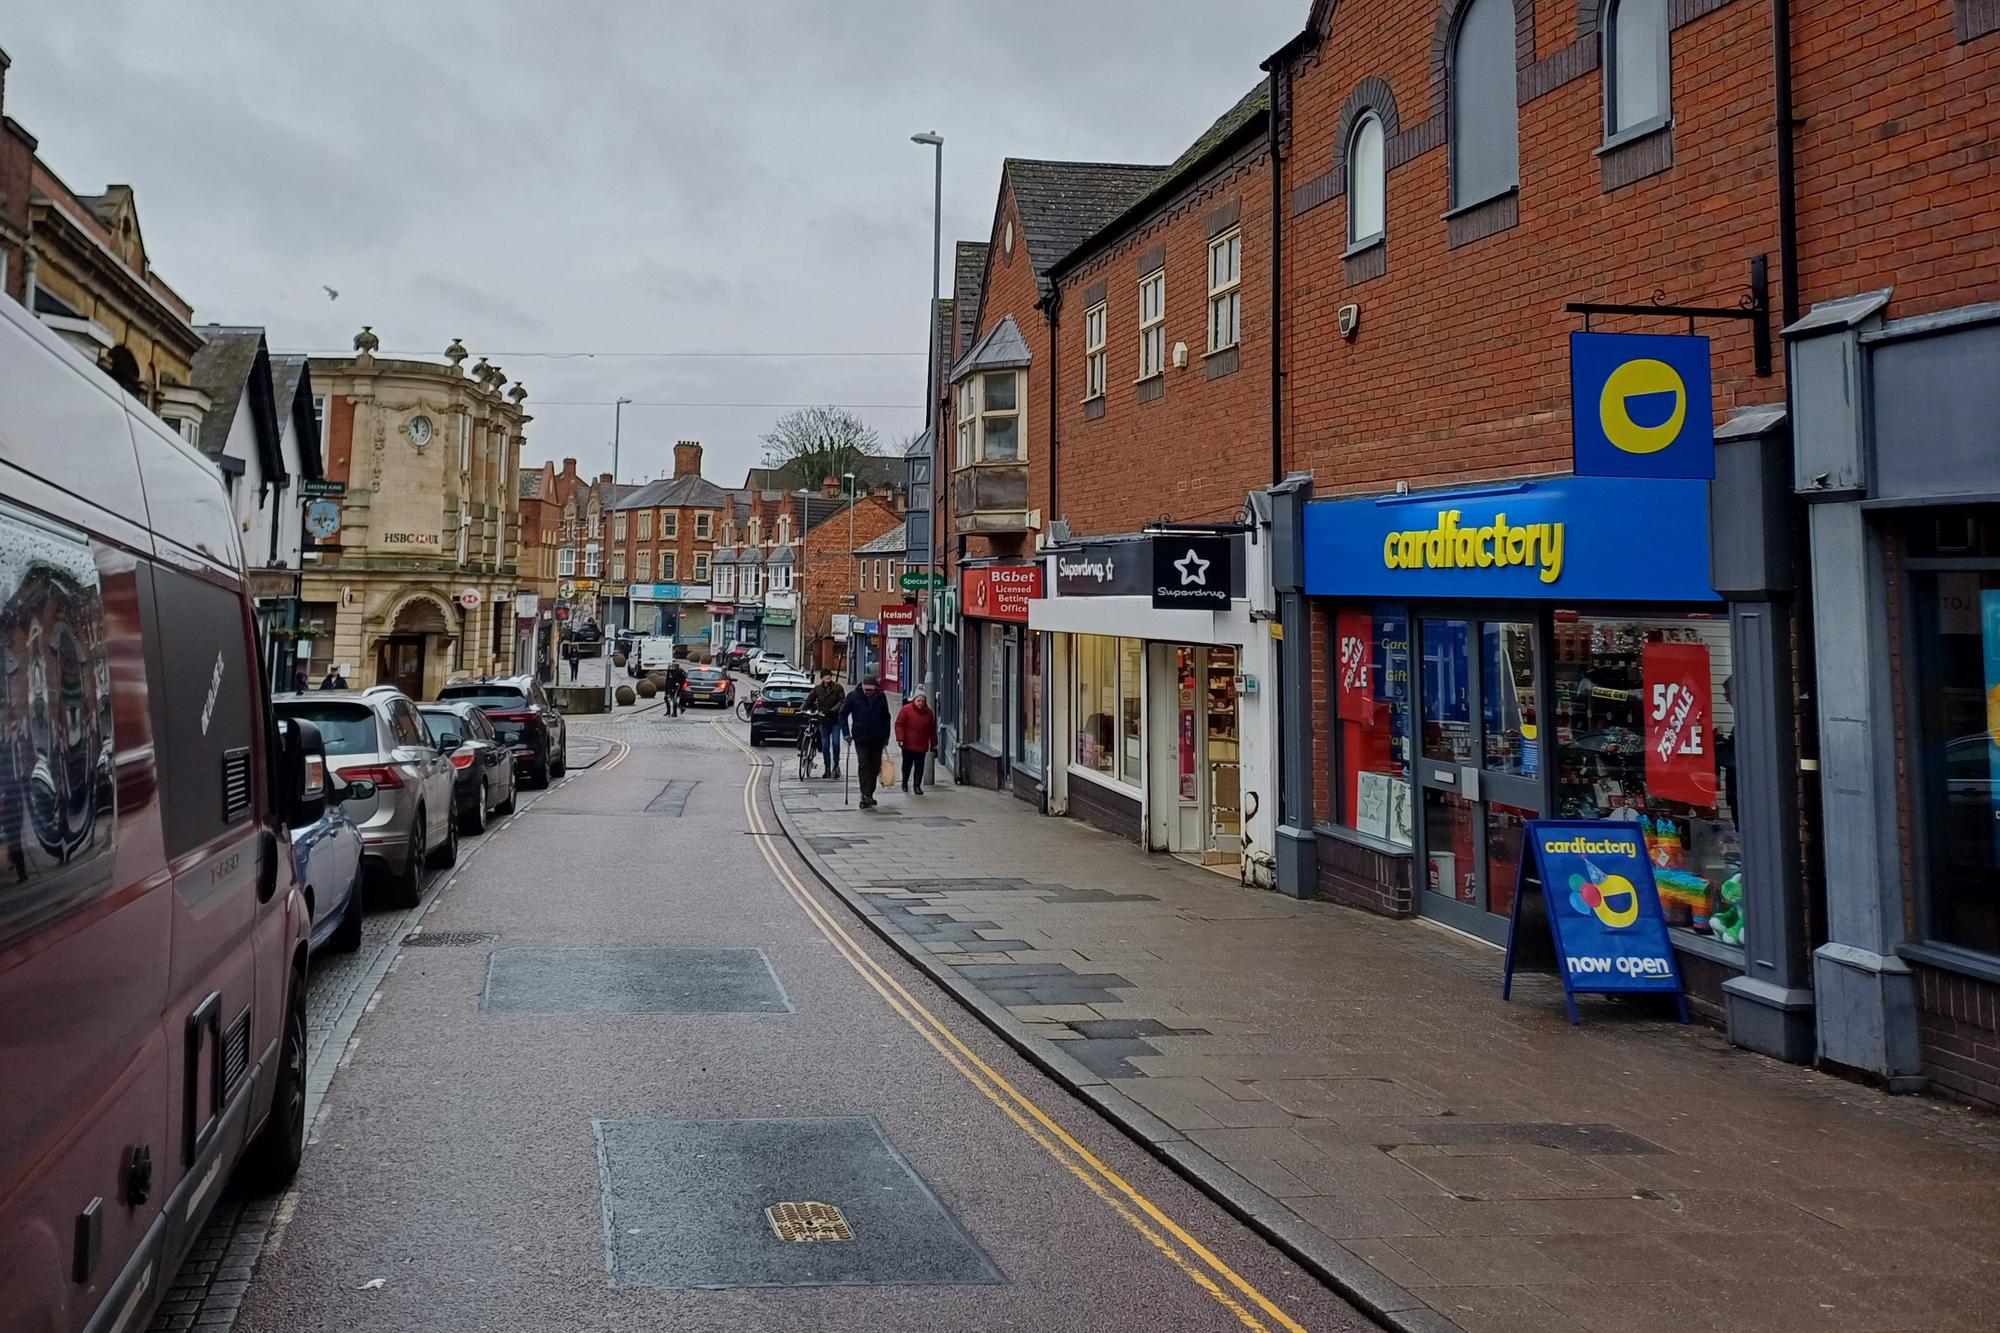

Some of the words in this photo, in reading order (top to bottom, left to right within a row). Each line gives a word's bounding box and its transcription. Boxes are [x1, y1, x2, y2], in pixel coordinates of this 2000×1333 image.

[384, 533, 415, 543] HSBC
[428, 534, 439, 544] UK
[1384, 509, 1564, 584] cardfactory
[1059, 557, 1104, 583] Superdrug
[903, 577, 941, 587] Specsars
[991, 571, 1036, 582] BGbet
[995, 584, 1031, 593] Licensed
[1157, 586, 1226, 600] Superdrug
[998, 594, 1029, 605] Betting
[1000, 604, 1027, 613] Office
[883, 611, 912, 620] Iceland
[1669, 685, 1695, 734] SALE
[1545, 837, 1636, 858] cardfactory
[1566, 956, 1612, 973] now
[1615, 956, 1670, 978] open
